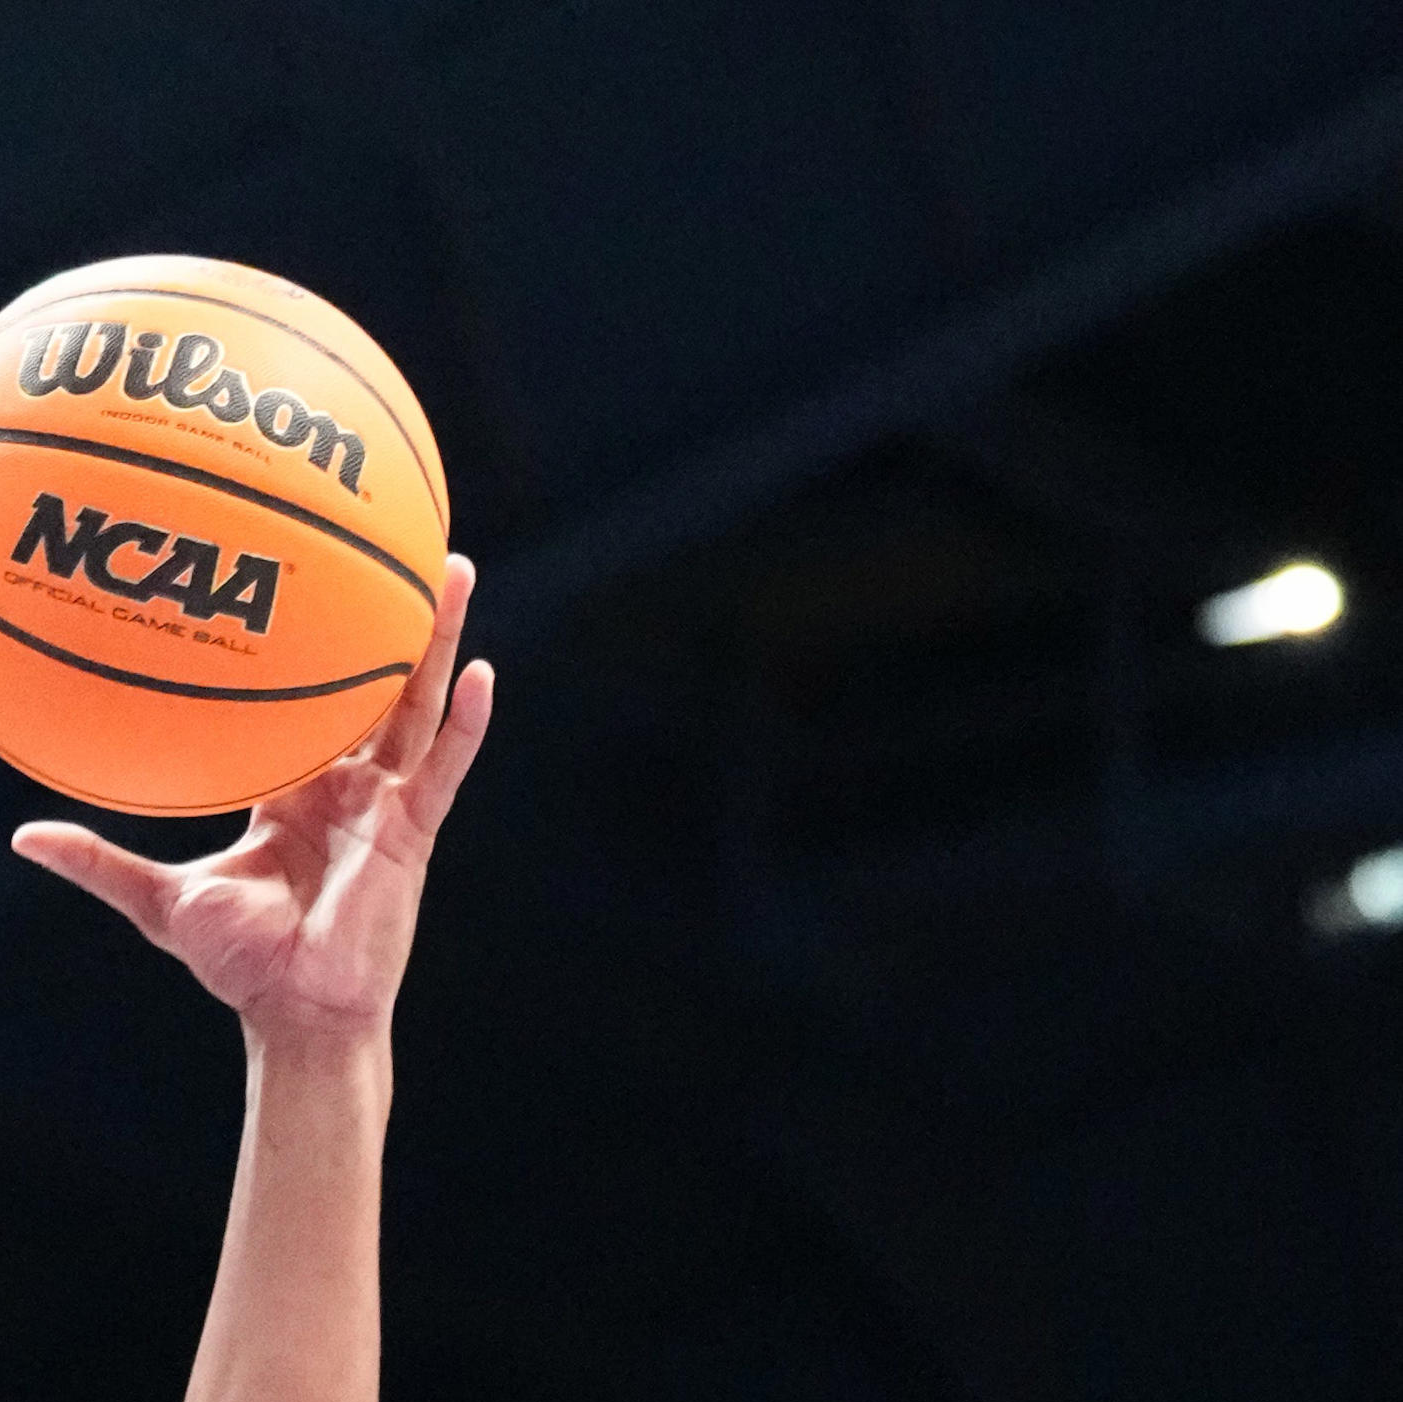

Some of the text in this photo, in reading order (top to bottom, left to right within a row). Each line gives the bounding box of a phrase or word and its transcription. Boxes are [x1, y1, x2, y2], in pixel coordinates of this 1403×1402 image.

[19, 321, 366, 497] Wilson
[100, 409, 272, 467] INDOOR GAME BALL
[3, 570, 260, 656] OFFICIAL GAME BALL
[9, 491, 281, 635] NCAA
